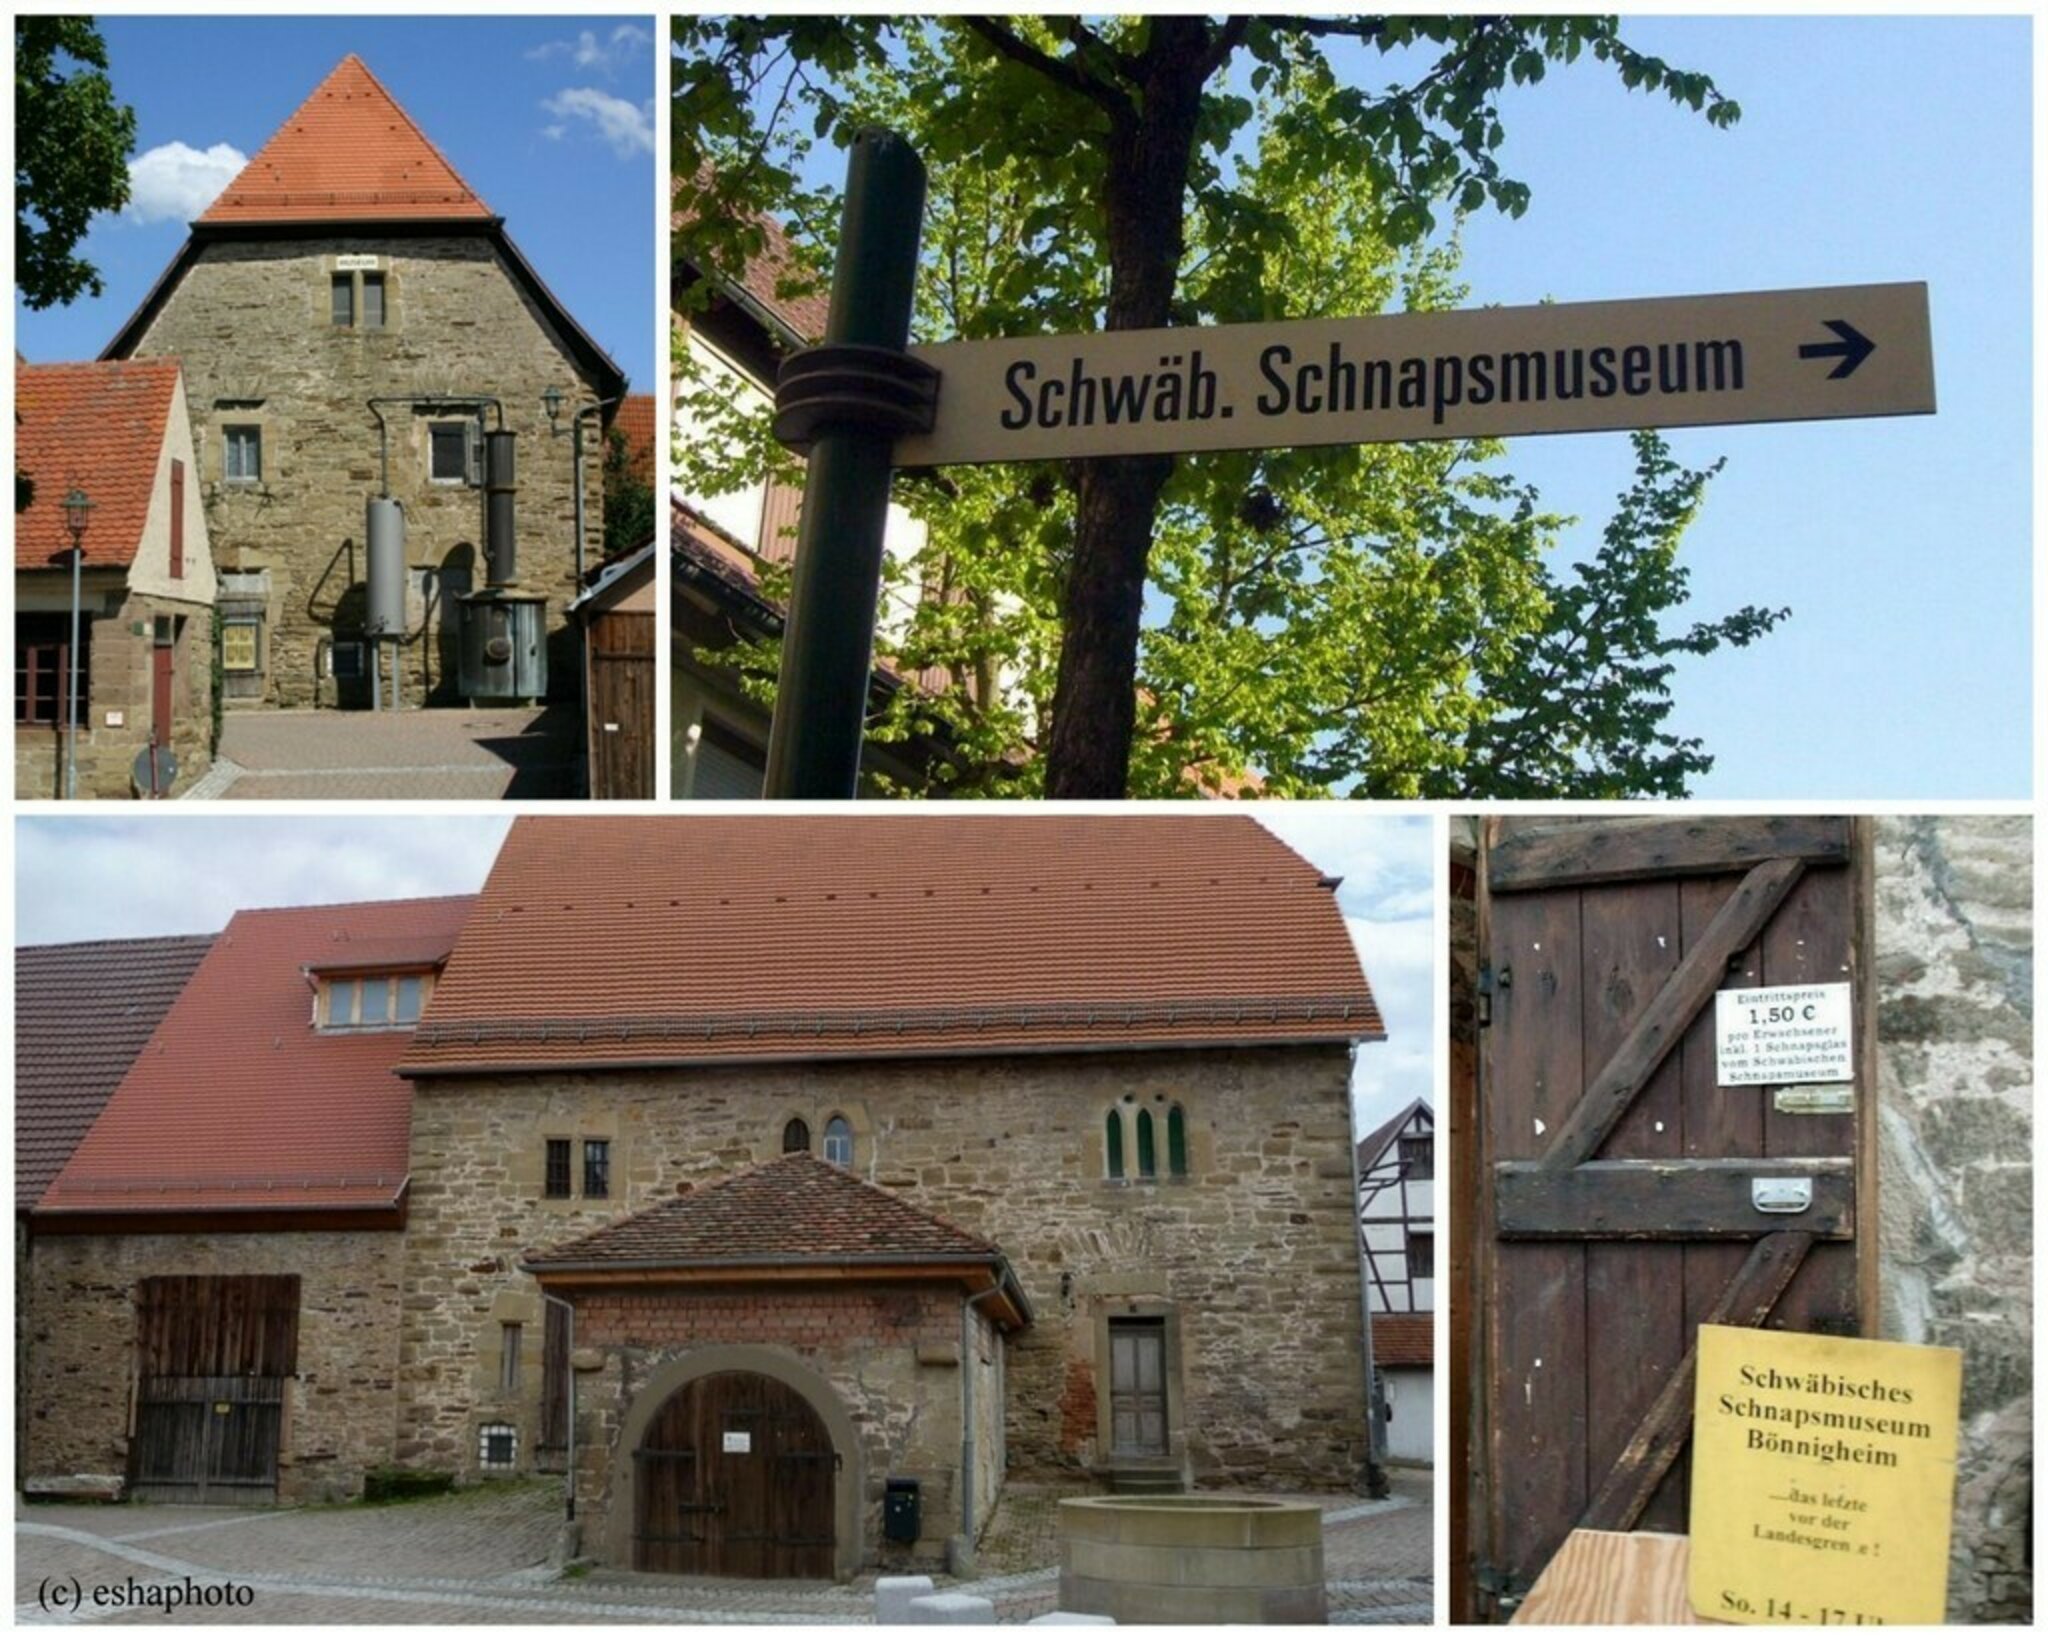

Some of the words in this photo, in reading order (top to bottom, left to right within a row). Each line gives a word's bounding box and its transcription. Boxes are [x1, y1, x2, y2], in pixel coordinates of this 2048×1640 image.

[1000, 355, 1234, 430] Schwäb.
[1257, 338, 1744, 424] Schnapsmuseum
[1737, 991, 1825, 1004] Eintrittspreis
[1750, 1006, 1794, 1025] 1,50
[1802, 1005, 1815, 1021] €
[1728, 1032, 1748, 1043] pro
[1753, 1027, 1837, 1038] Erwachsener
[1766, 1040, 1847, 1052] Schnapsglas
[1721, 1060, 1748, 1068] vom
[1729, 1071, 1839, 1081] Schnapsmuseum
[1740, 1364, 1913, 1404] Schwäbisches
[1719, 1394, 1931, 1438] Schnapsmuseum
[1747, 1429, 1898, 1467] Bönnigheim
[1789, 1512, 1817, 1526] vor
[1821, 1515, 1851, 1530] der
[1721, 1590, 1756, 1615] So.
[1767, 1598, 1791, 1619] 14
[1821, 1608, 1846, 1626] 17
